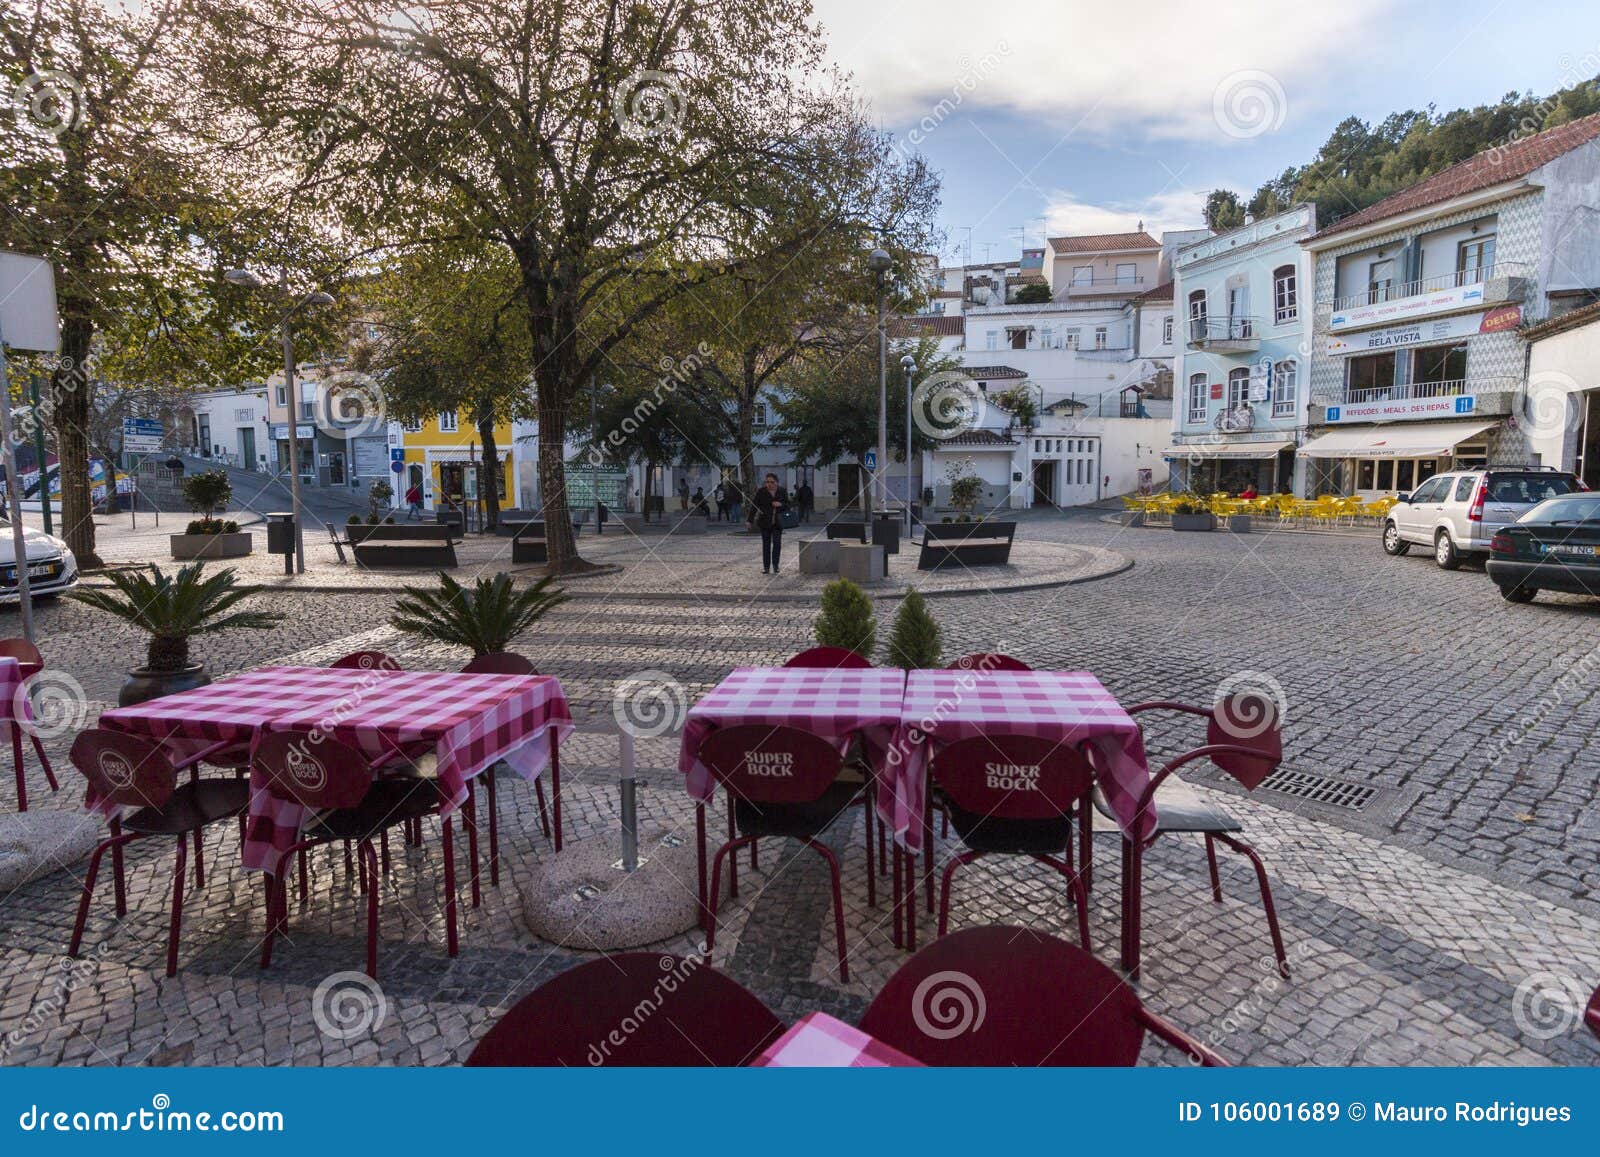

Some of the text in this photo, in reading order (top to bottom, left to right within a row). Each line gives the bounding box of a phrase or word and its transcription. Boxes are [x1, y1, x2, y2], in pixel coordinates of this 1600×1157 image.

[1485, 311, 1519, 328] DELTA
[1368, 336, 1391, 347] BELA
[1394, 332, 1421, 344] VISTA
[1384, 405, 1407, 414] MEALS
[1410, 404, 1425, 413] DES
[1426, 402, 1450, 412] REPAS
[744, 751, 793, 764] SUPER
[747, 763, 794, 776] BOCK
[984, 762, 1041, 778] SUPER
[987, 775, 1039, 791] BOCK
